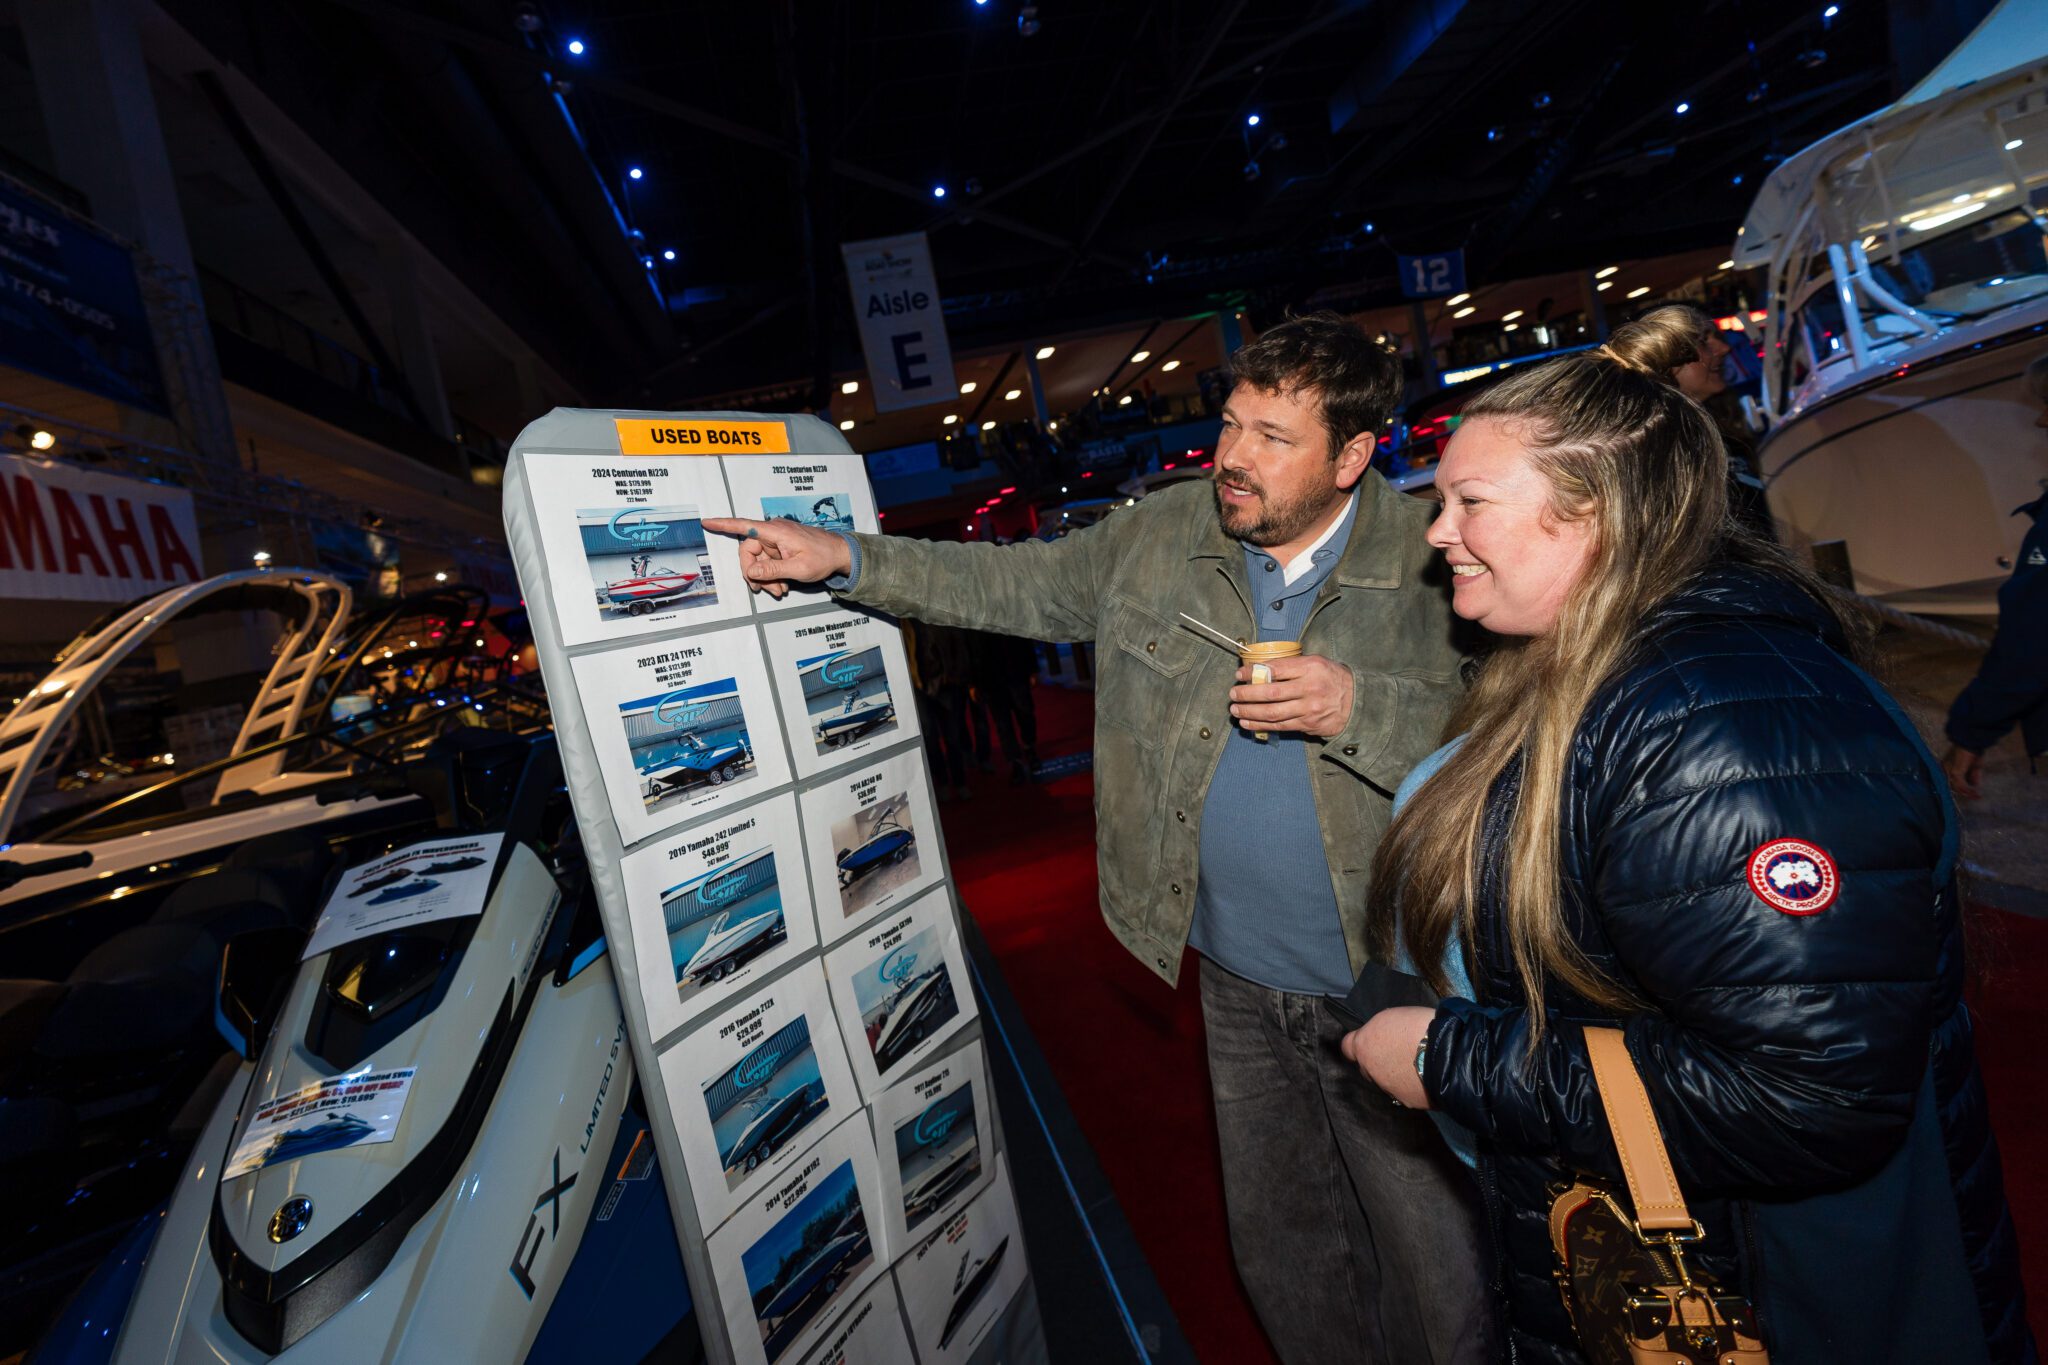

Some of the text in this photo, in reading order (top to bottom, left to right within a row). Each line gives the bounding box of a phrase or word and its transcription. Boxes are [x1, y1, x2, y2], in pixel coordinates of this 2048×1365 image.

[1411, 257, 1453, 293] 12
[867, 290, 929, 318] Aisle
[892, 332, 932, 391] E
[650, 428, 762, 446] USED BOATS
[591, 468, 611, 478] 2024
[611, 468, 648, 478] Centurion
[825, 620, 853, 632] Wakesetter
[637, 647, 703, 668] 2023 ATX 24 TYPE-S
[422, 842, 480, 854] WAVERUNNERS
[668, 818, 756, 860] 2019 Yamaha 242 Limited S
[1758, 843, 1817, 863] CANADA GOOSE
[1766, 889, 1830, 908] ARCTIC PROGRAM
[719, 1023, 736, 1039] 2016
[735, 1008, 761, 1028] Yamaha
[361, 1072, 391, 1083] Limited
[320, 1098, 339, 1107] Now:
[580, 1064, 615, 1155] LIMITED
[780, 1173, 803, 1198] Yamaha
[509, 1145, 579, 1302] FX
